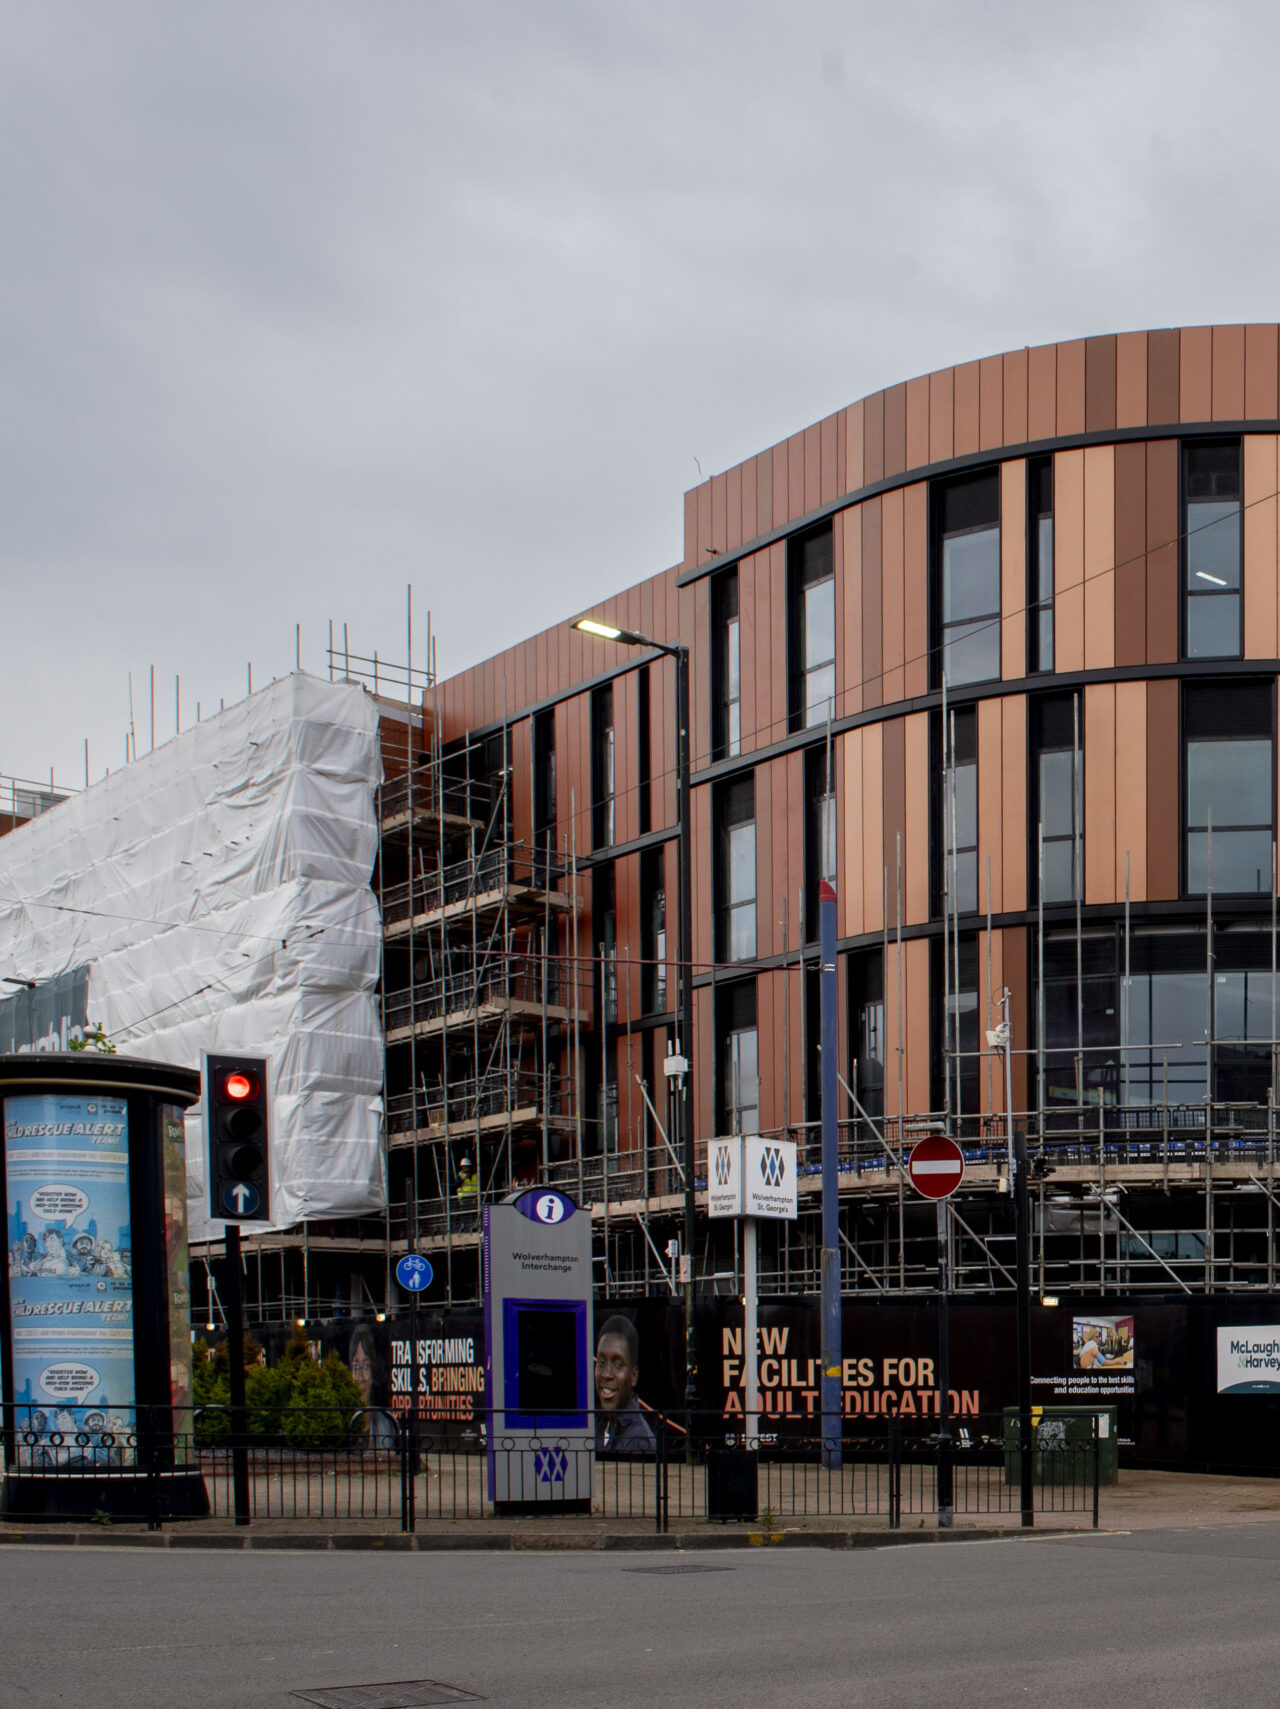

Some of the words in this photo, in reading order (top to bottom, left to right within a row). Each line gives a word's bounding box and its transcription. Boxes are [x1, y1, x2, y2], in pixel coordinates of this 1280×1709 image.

[753, 1193, 793, 1203] Wolverhampton
[512, 1252, 579, 1263] Wolverhampton
[522, 1262, 572, 1273] Interchange
[723, 1358, 874, 1387] FCILIES
[883, 1358, 935, 1387] FOR
[391, 1368, 430, 1396] SKILS,
[431, 1366, 485, 1392] BRINGING
[1030, 1376, 1067, 1385] Connecting
[1068, 1377, 1090, 1385] people
[1054, 1386, 1067, 1394] and
[1068, 1386, 1099, 1394] education
[1100, 1387, 1135, 1395] opportunities
[391, 1395, 474, 1420] OPPRTUNITIES
[840, 1390, 980, 1419] DUCATION
